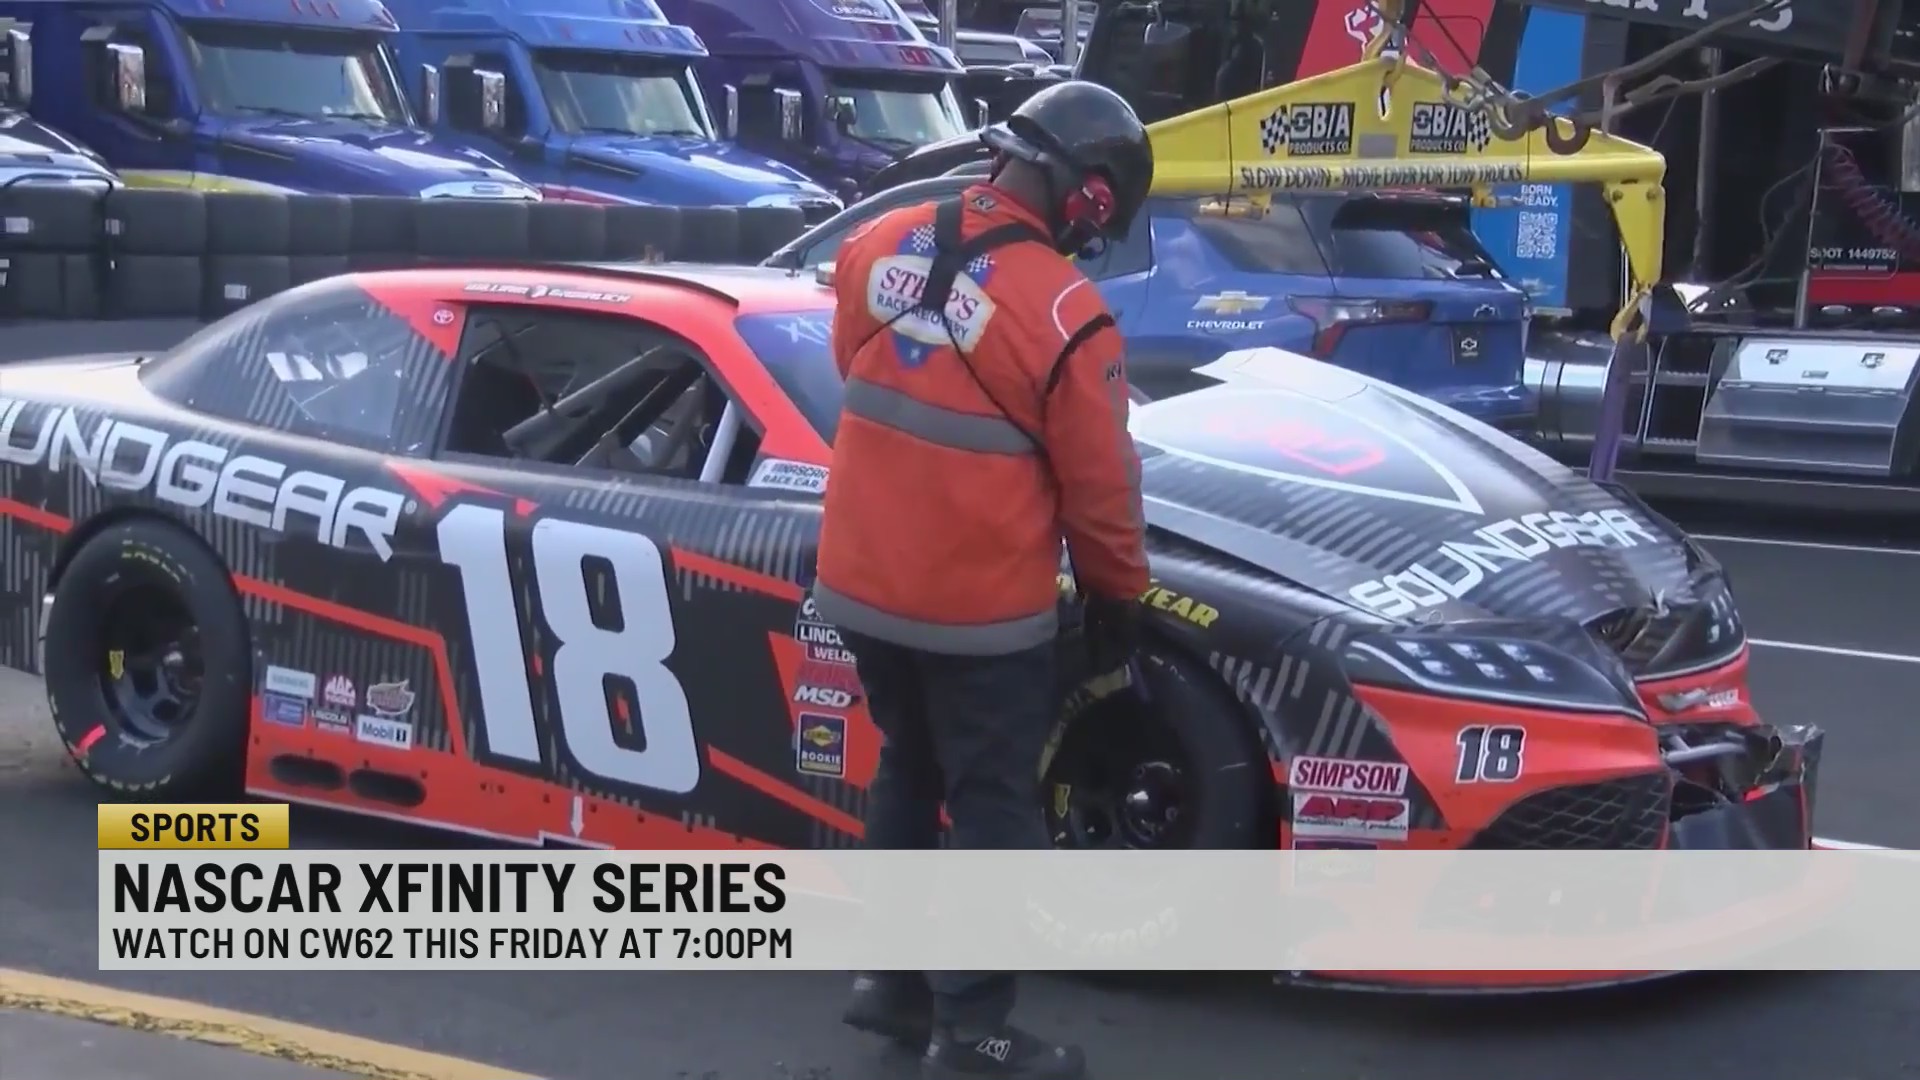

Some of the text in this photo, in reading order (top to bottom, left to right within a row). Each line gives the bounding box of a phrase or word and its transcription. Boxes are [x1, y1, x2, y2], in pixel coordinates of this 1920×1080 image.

[1290, 141, 1335, 154] PRODUCTS
[1241, 167, 1281, 188] SLOW
[1285, 167, 1331, 188] DOWN
[1342, 167, 1382, 188] MOVE
[1384, 166, 1418, 187] OVER
[1420, 165, 1445, 185] FOR
[1447, 164, 1475, 184] TOW
[1521, 184, 1552, 195] BORN
[877, 293, 969, 341] RACE RECOERY
[1187, 320, 1265, 331] CHEVROLET
[0, 399, 404, 562] UNDGEAR
[761, 474, 819, 488] RACE CAR
[1349, 508, 1658, 617] SOUNDGEAR
[437, 503, 700, 794] 18
[794, 685, 852, 709] MSD
[362, 721, 394, 742] Mobil
[801, 750, 842, 766] ROOKIE
[1456, 724, 1526, 784] 18
[1295, 759, 1402, 793] SIMPSON
